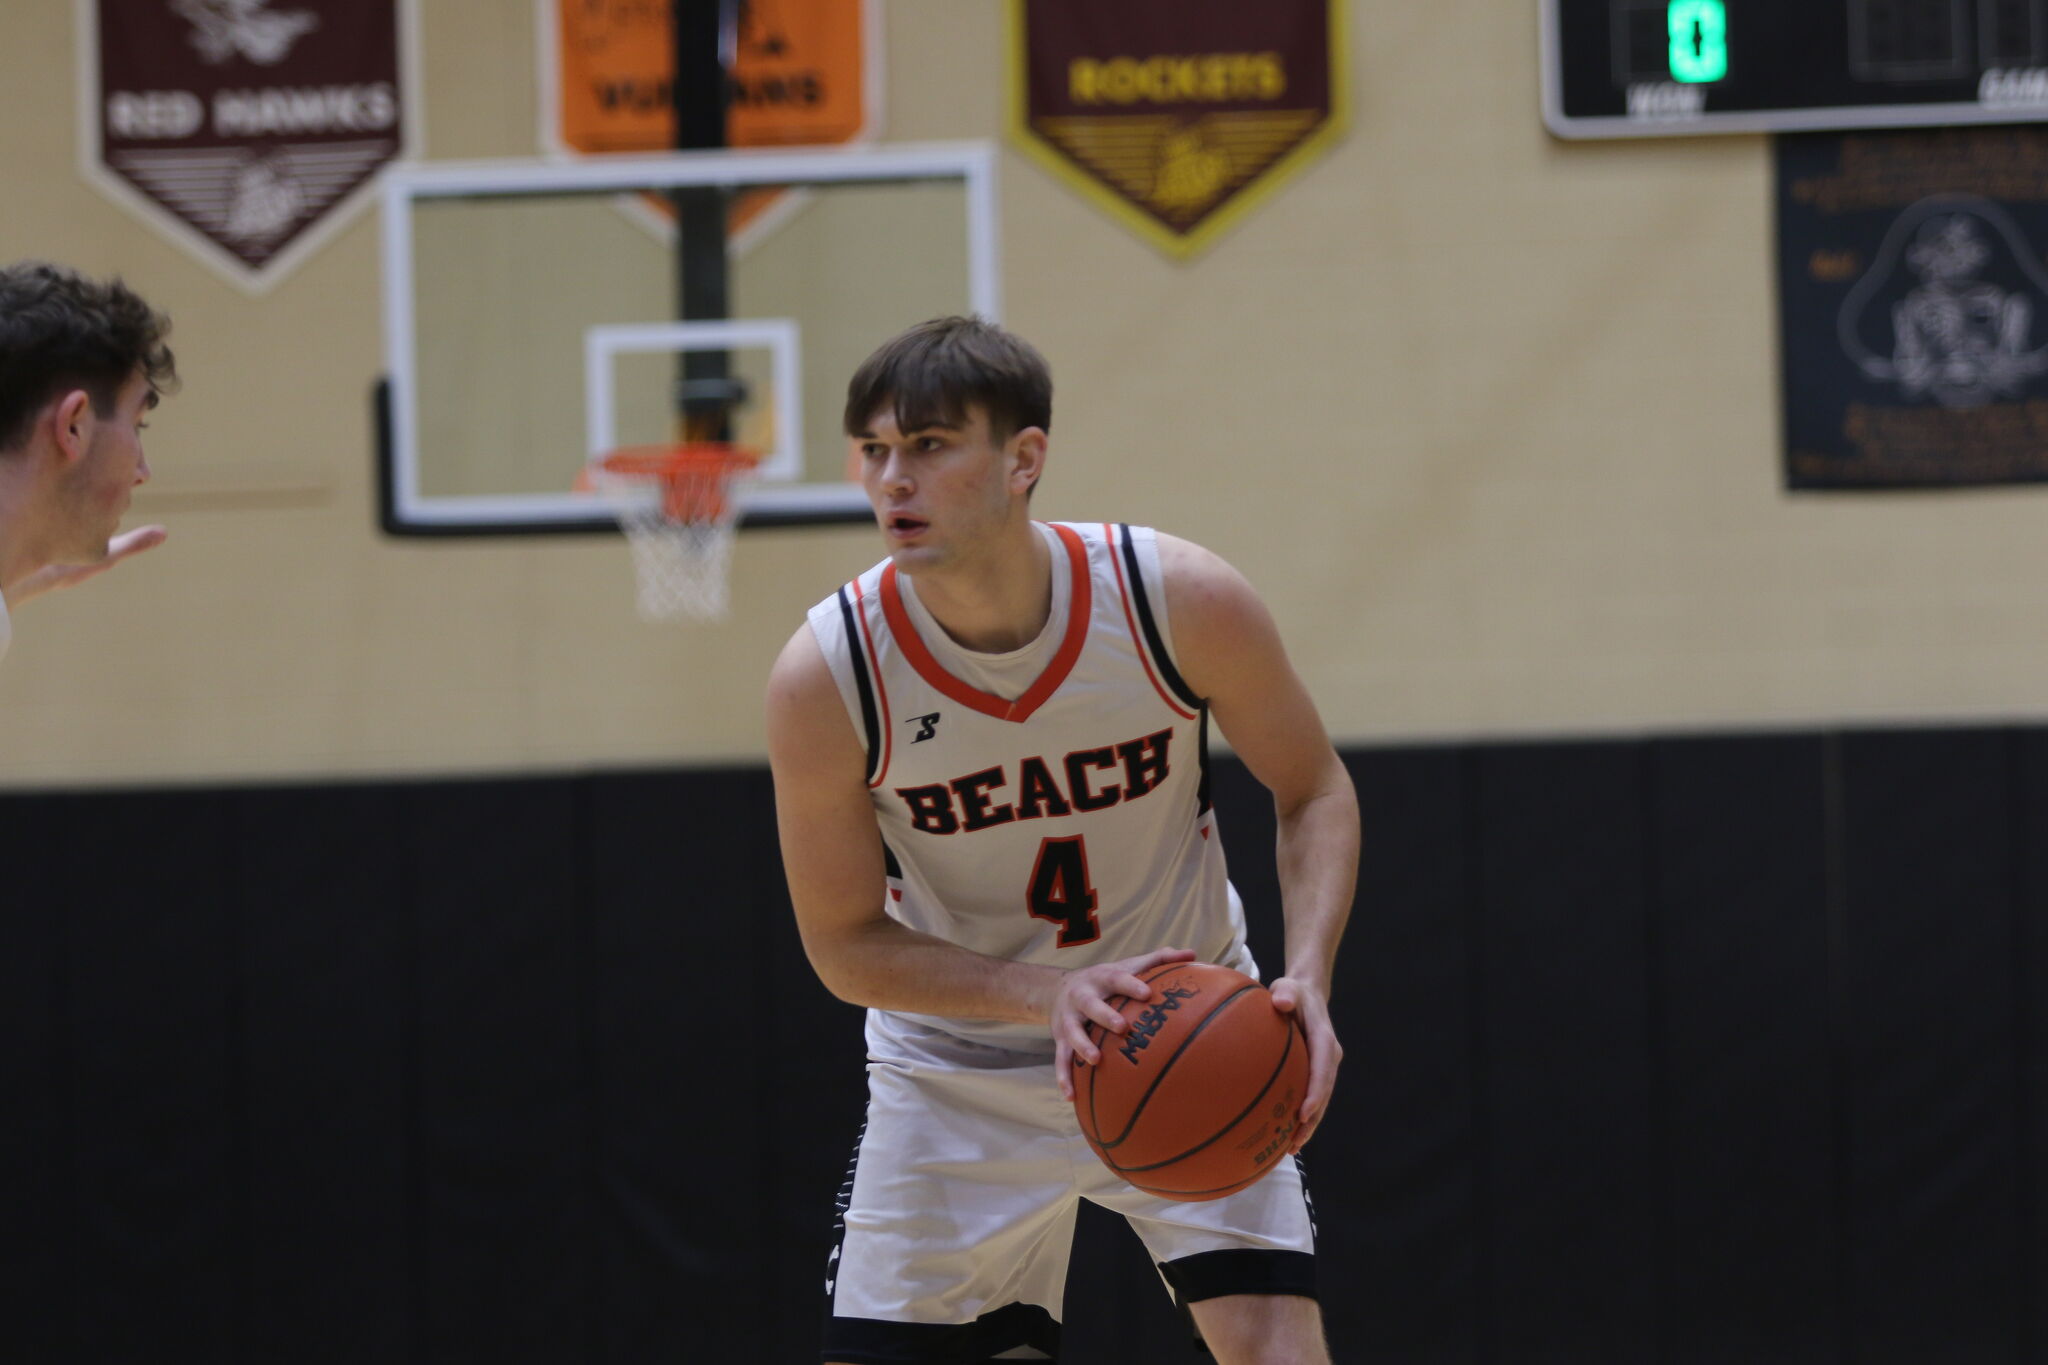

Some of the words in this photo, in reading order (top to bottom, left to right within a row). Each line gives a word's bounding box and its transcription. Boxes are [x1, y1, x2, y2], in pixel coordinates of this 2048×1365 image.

[109, 89, 204, 139] RED
[212, 80, 396, 138] HAWKS
[1069, 53, 1286, 105] ROCKETS
[894, 727, 1173, 835] BEACH
[1025, 834, 1101, 949] 4
